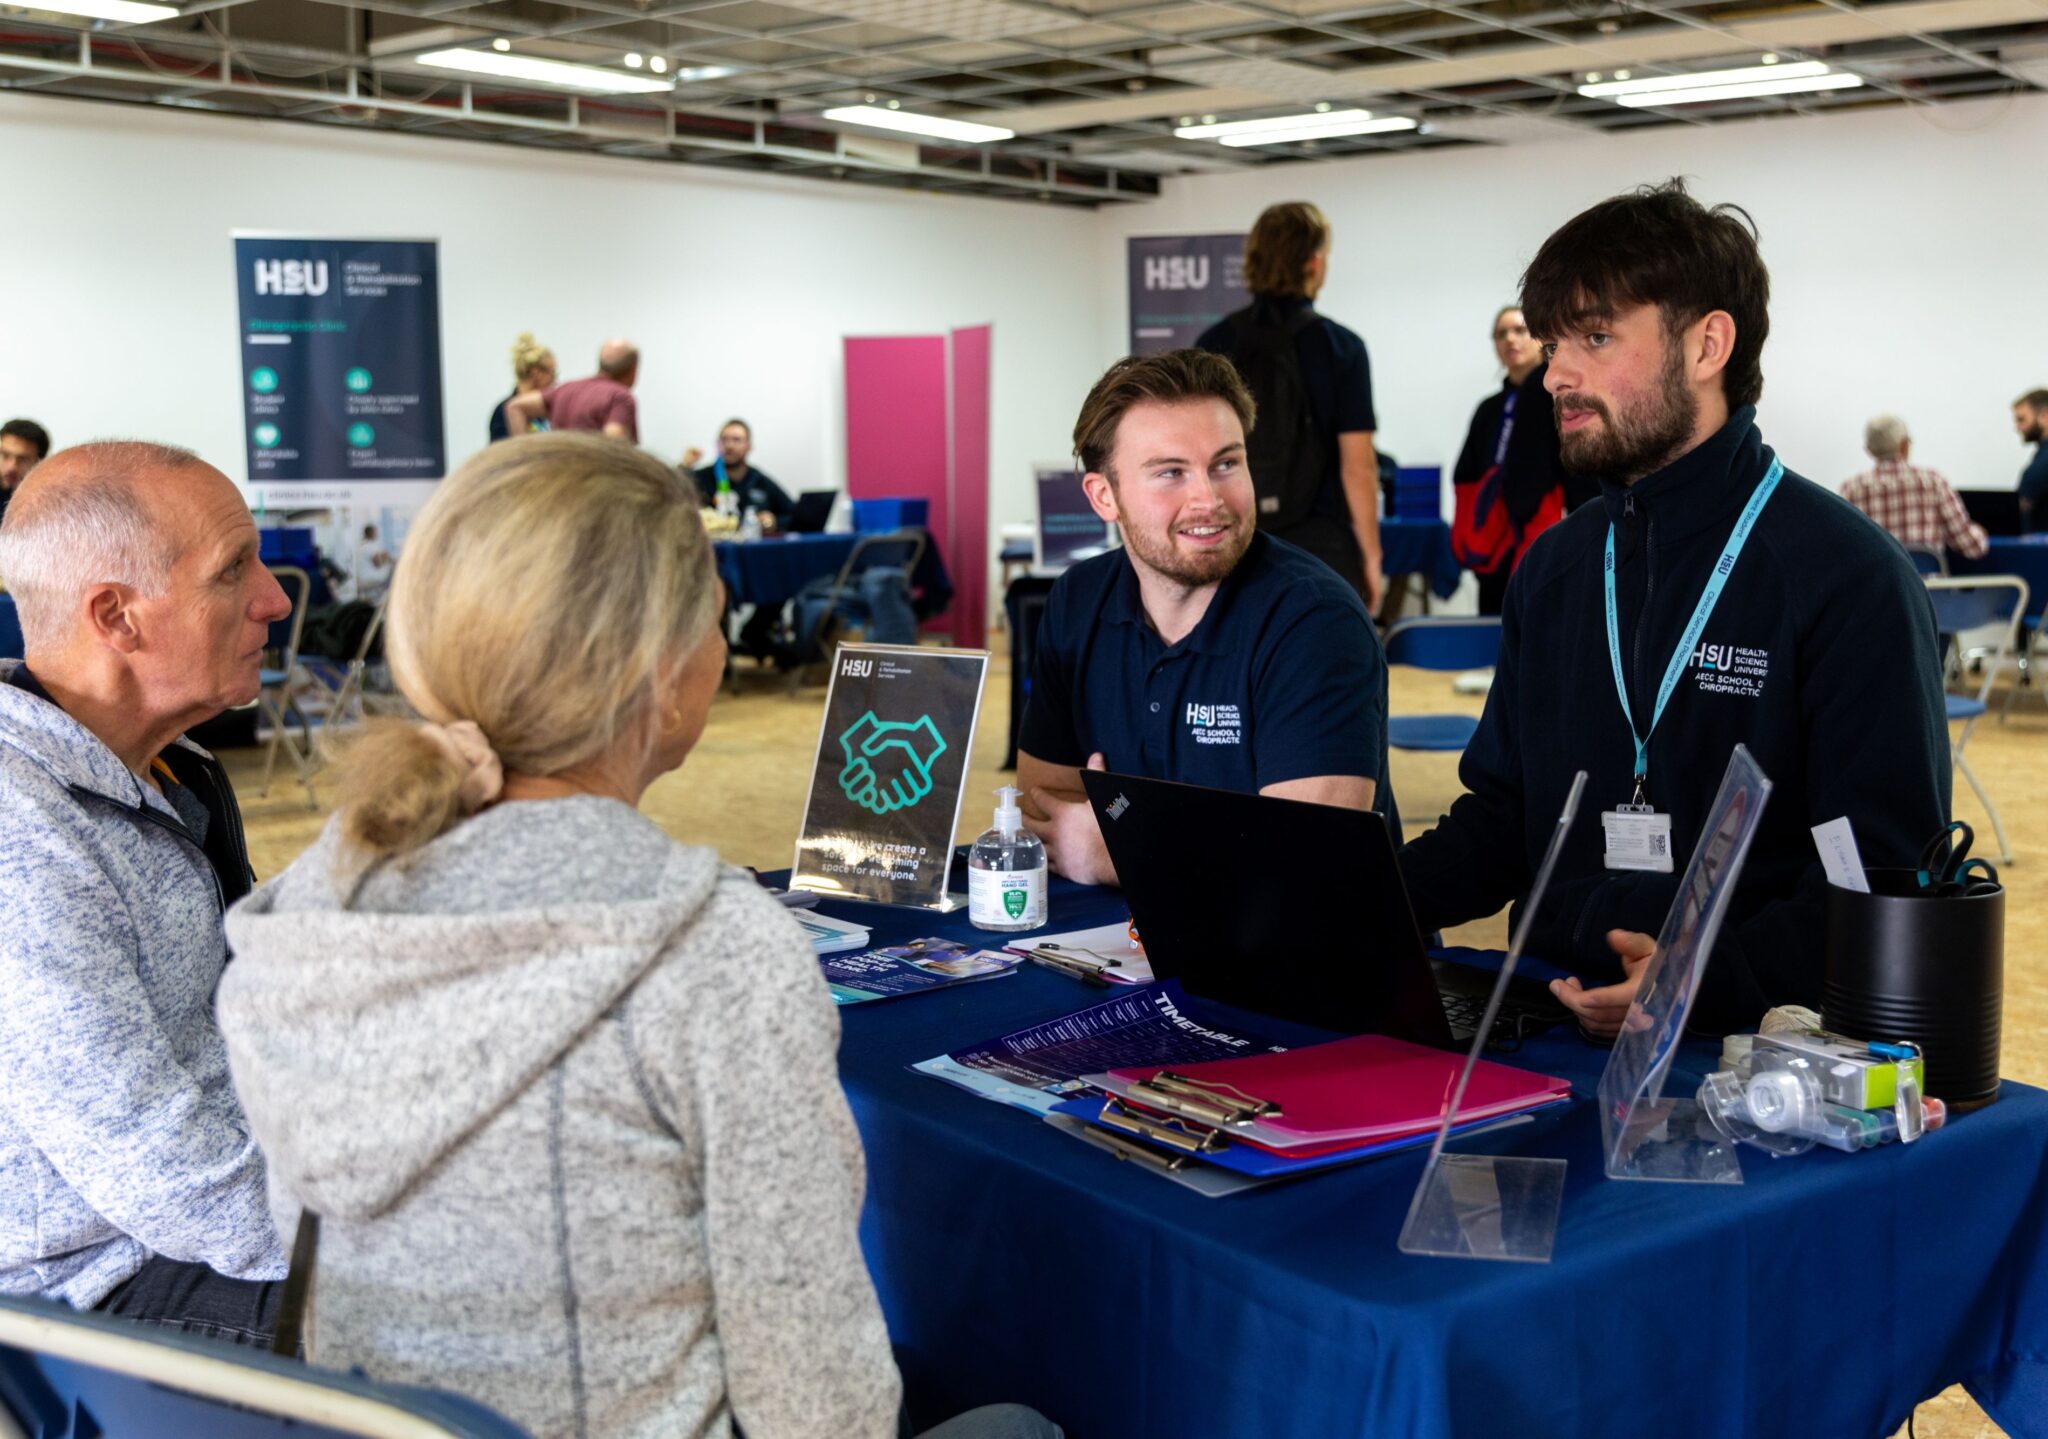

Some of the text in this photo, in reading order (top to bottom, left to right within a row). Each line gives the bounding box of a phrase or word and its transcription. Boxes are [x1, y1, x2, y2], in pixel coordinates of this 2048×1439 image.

[254, 259, 329, 296] HSU
[1144, 256, 1209, 289] HSU
[1718, 553, 1735, 575] HSU
[1700, 591, 1715, 616] Clinical
[1685, 615, 1703, 645] Services
[1668, 645, 1689, 682] Placement
[1689, 642, 1734, 671] HSU
[1735, 647, 1768, 658] HEALTH
[841, 659, 873, 677] HSU
[1695, 672, 1715, 682] AECC
[1717, 675, 1754, 687] SCHOOL
[1186, 702, 1215, 727] HSU
[1206, 729, 1235, 737] SCHOOL
[884, 843, 917, 854] create
[919, 846, 926, 855] a
[821, 863, 917, 881] space for everyone.
[1155, 991, 1250, 1047] TIMETABLE
